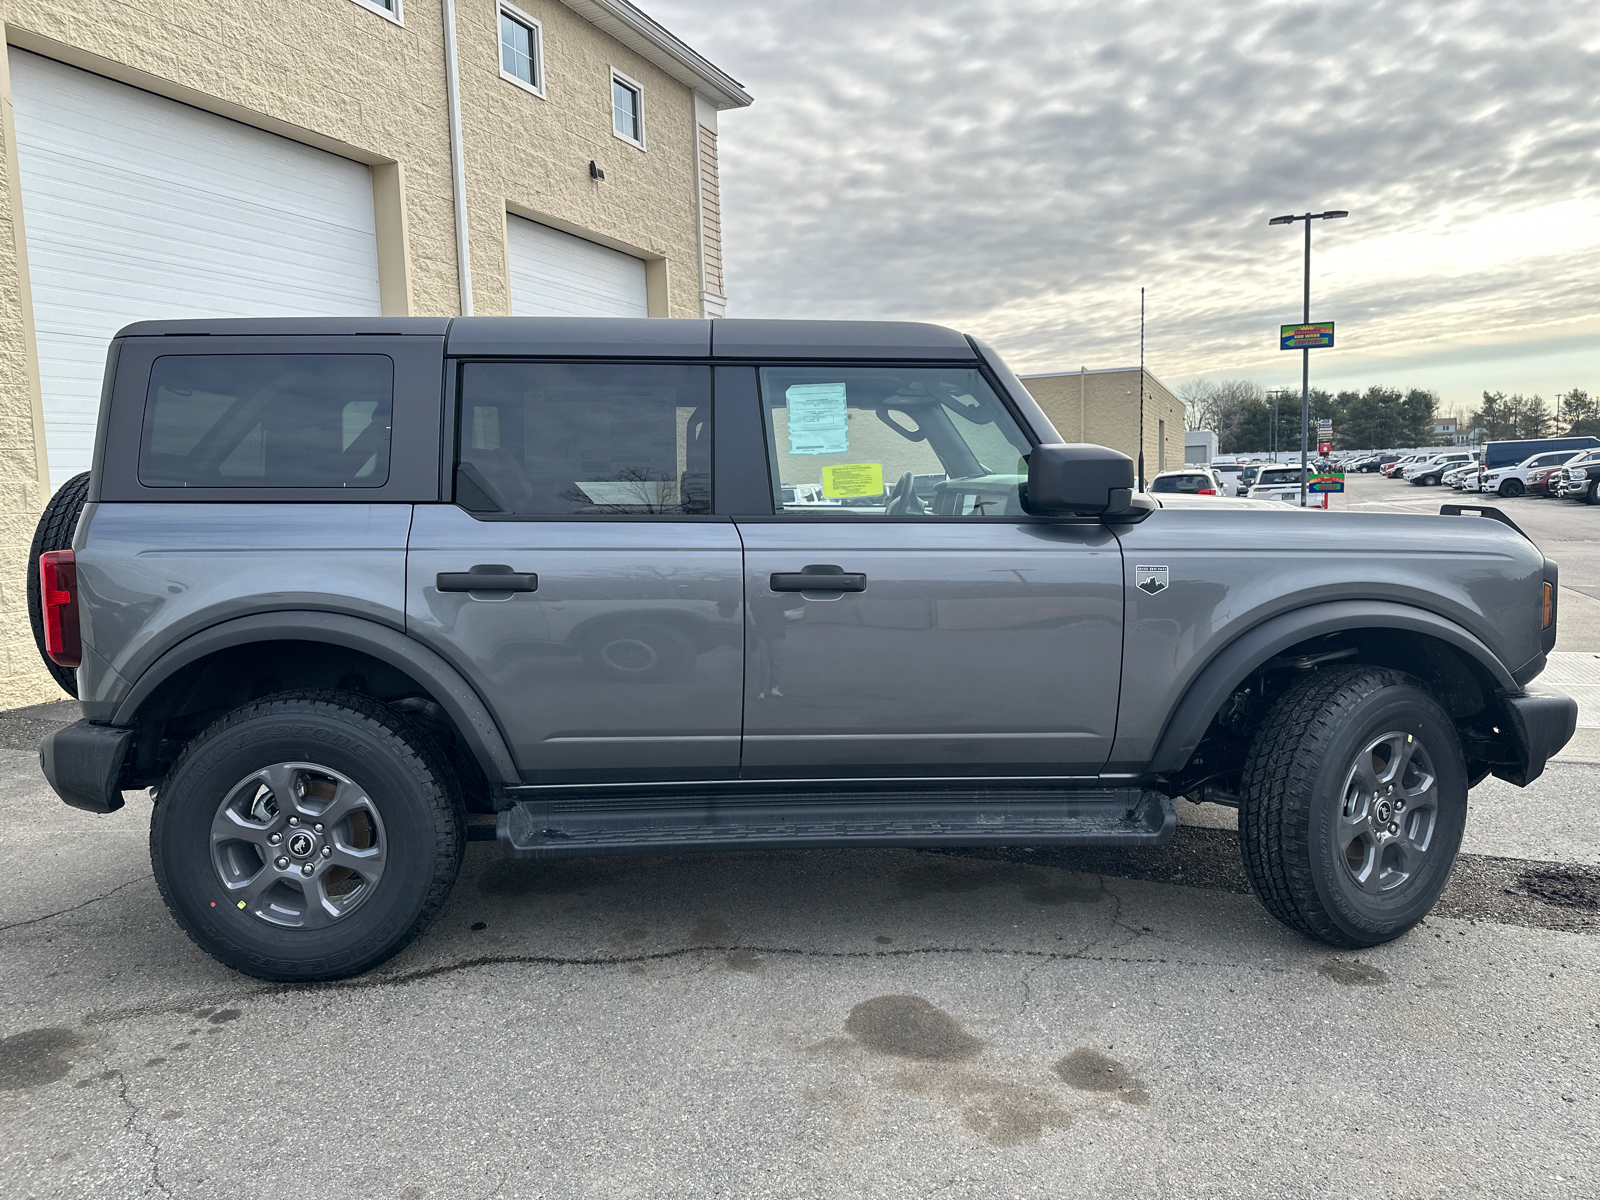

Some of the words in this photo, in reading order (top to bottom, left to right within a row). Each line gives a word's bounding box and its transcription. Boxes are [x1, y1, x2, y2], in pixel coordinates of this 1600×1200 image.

[175, 724, 373, 801] BRIDGESTONE
[1319, 795, 1396, 935] BRIDGESTONE
[246, 915, 397, 973] DUELER
